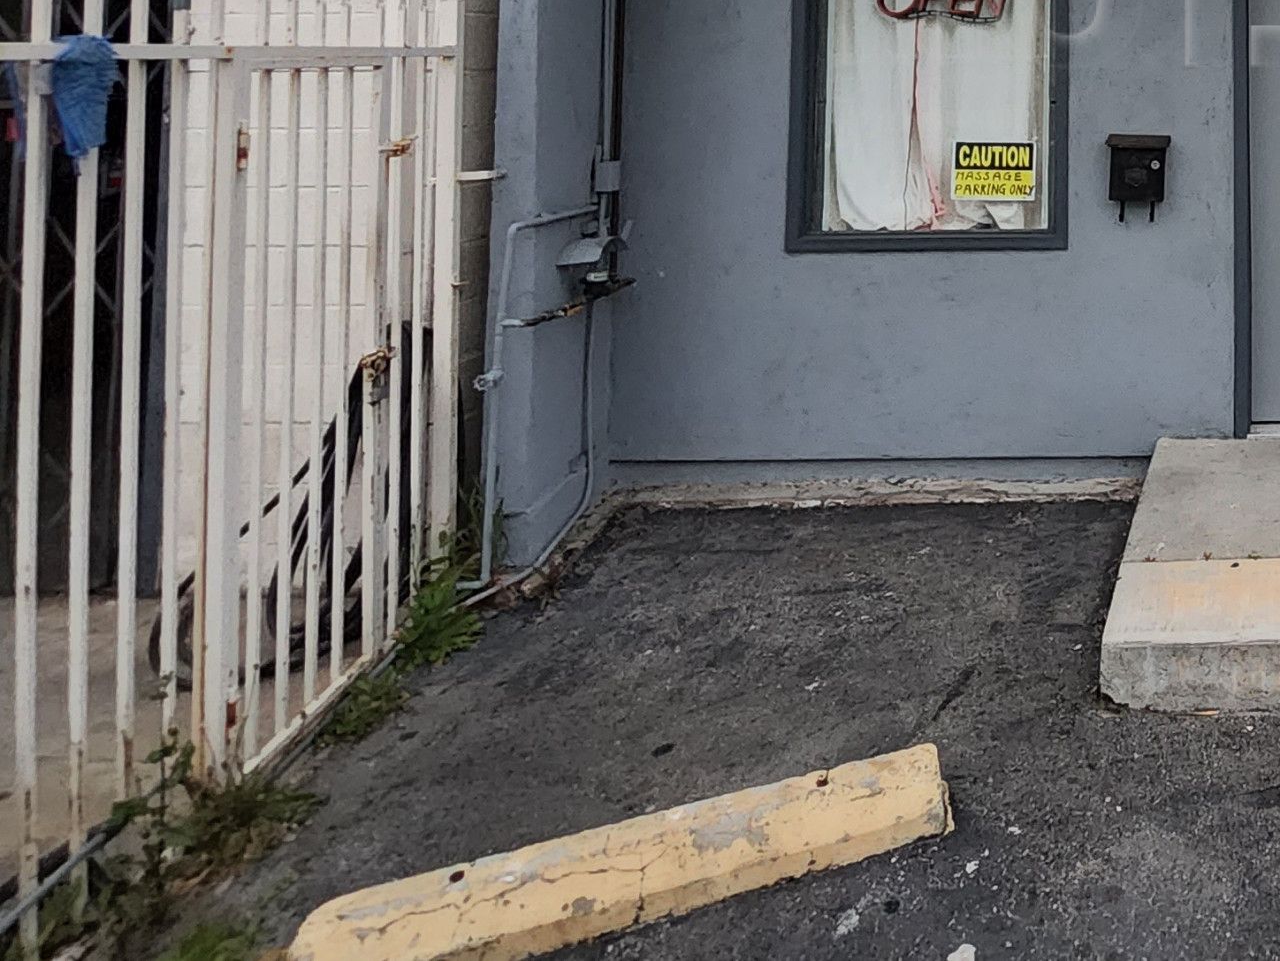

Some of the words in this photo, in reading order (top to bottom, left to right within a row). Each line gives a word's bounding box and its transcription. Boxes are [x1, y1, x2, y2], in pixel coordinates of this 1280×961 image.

[959, 145, 1030, 168] CAUTION
[955, 171, 1022, 182] MASSAGE
[954, 183, 1006, 196] PARKING
[1009, 184, 1035, 196] ONLY
